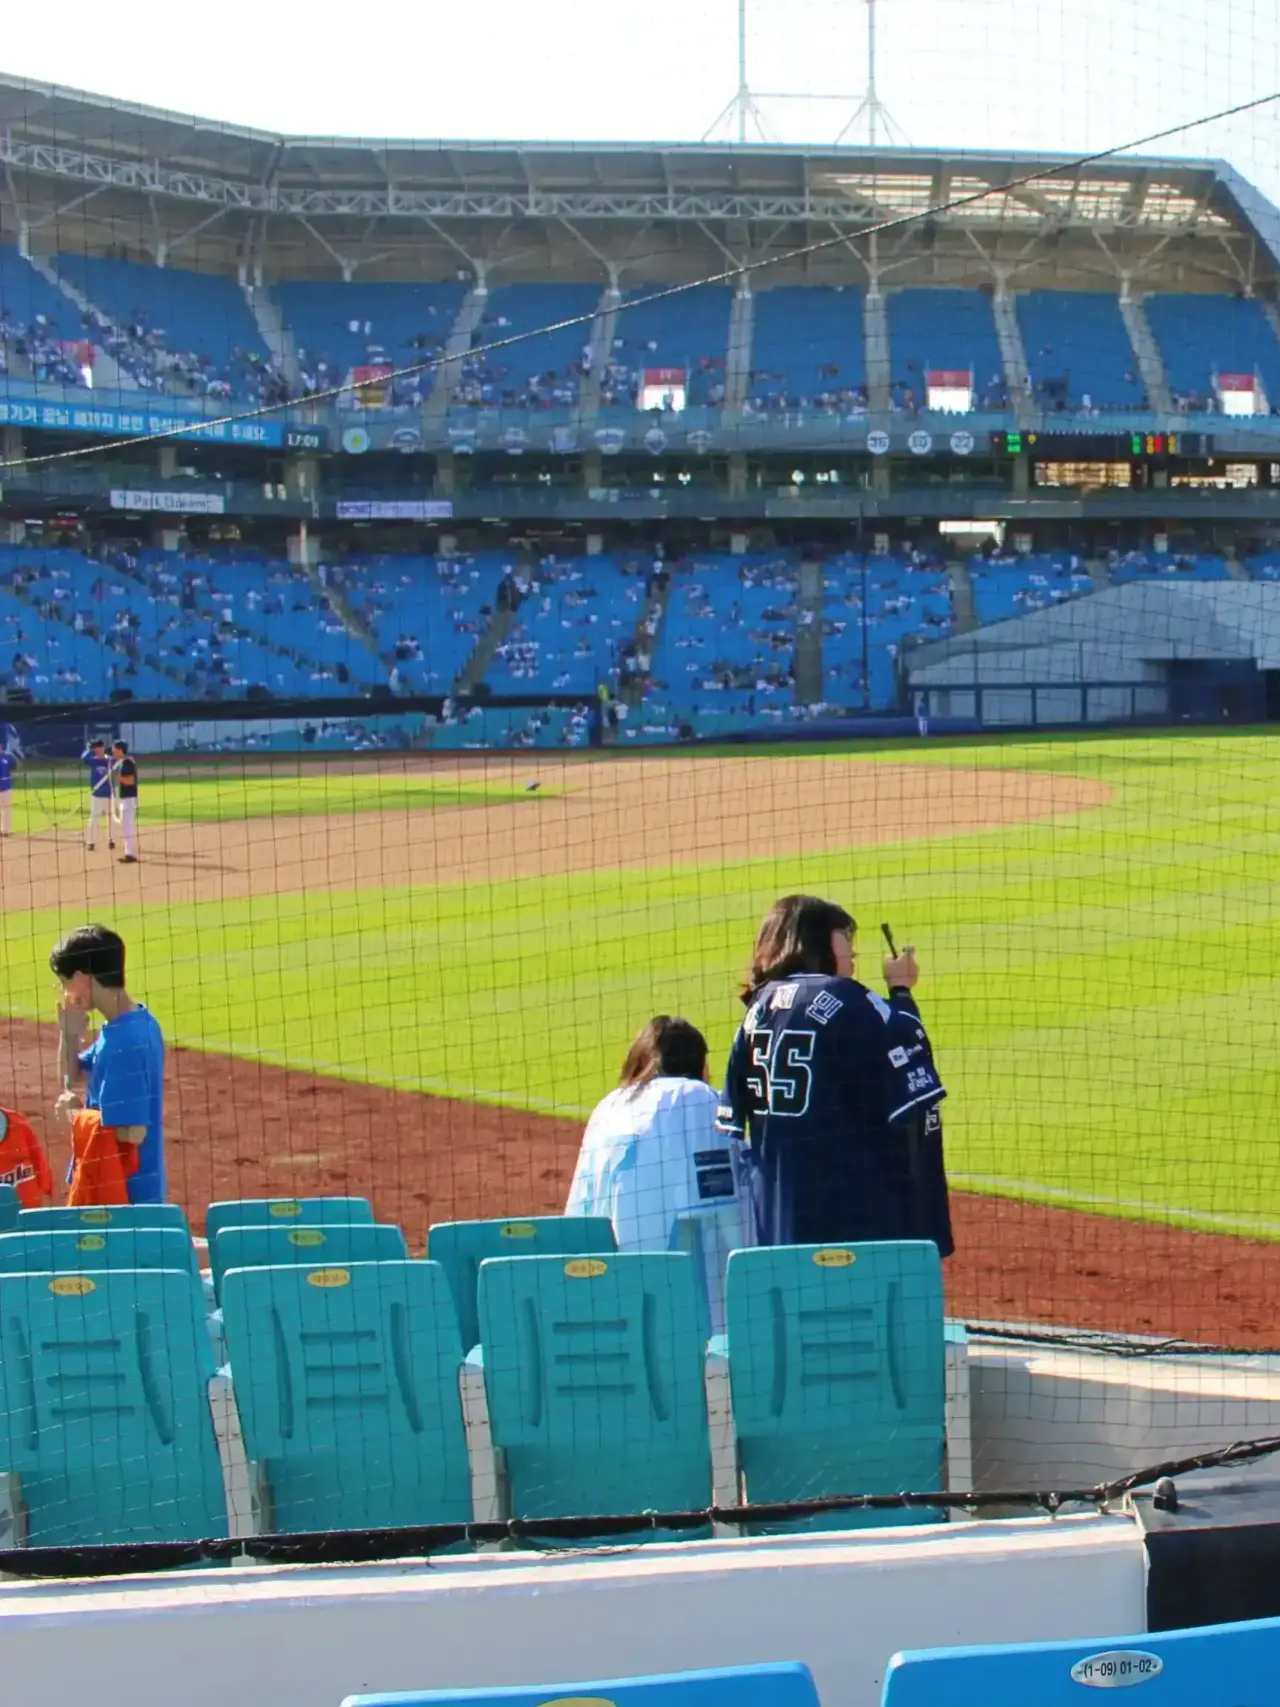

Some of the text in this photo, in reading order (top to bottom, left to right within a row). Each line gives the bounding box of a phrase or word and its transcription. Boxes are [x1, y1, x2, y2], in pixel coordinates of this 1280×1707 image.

[746, 1029, 816, 1117] 55
[1083, 1659, 1152, 1679] (1-09) 01-02
